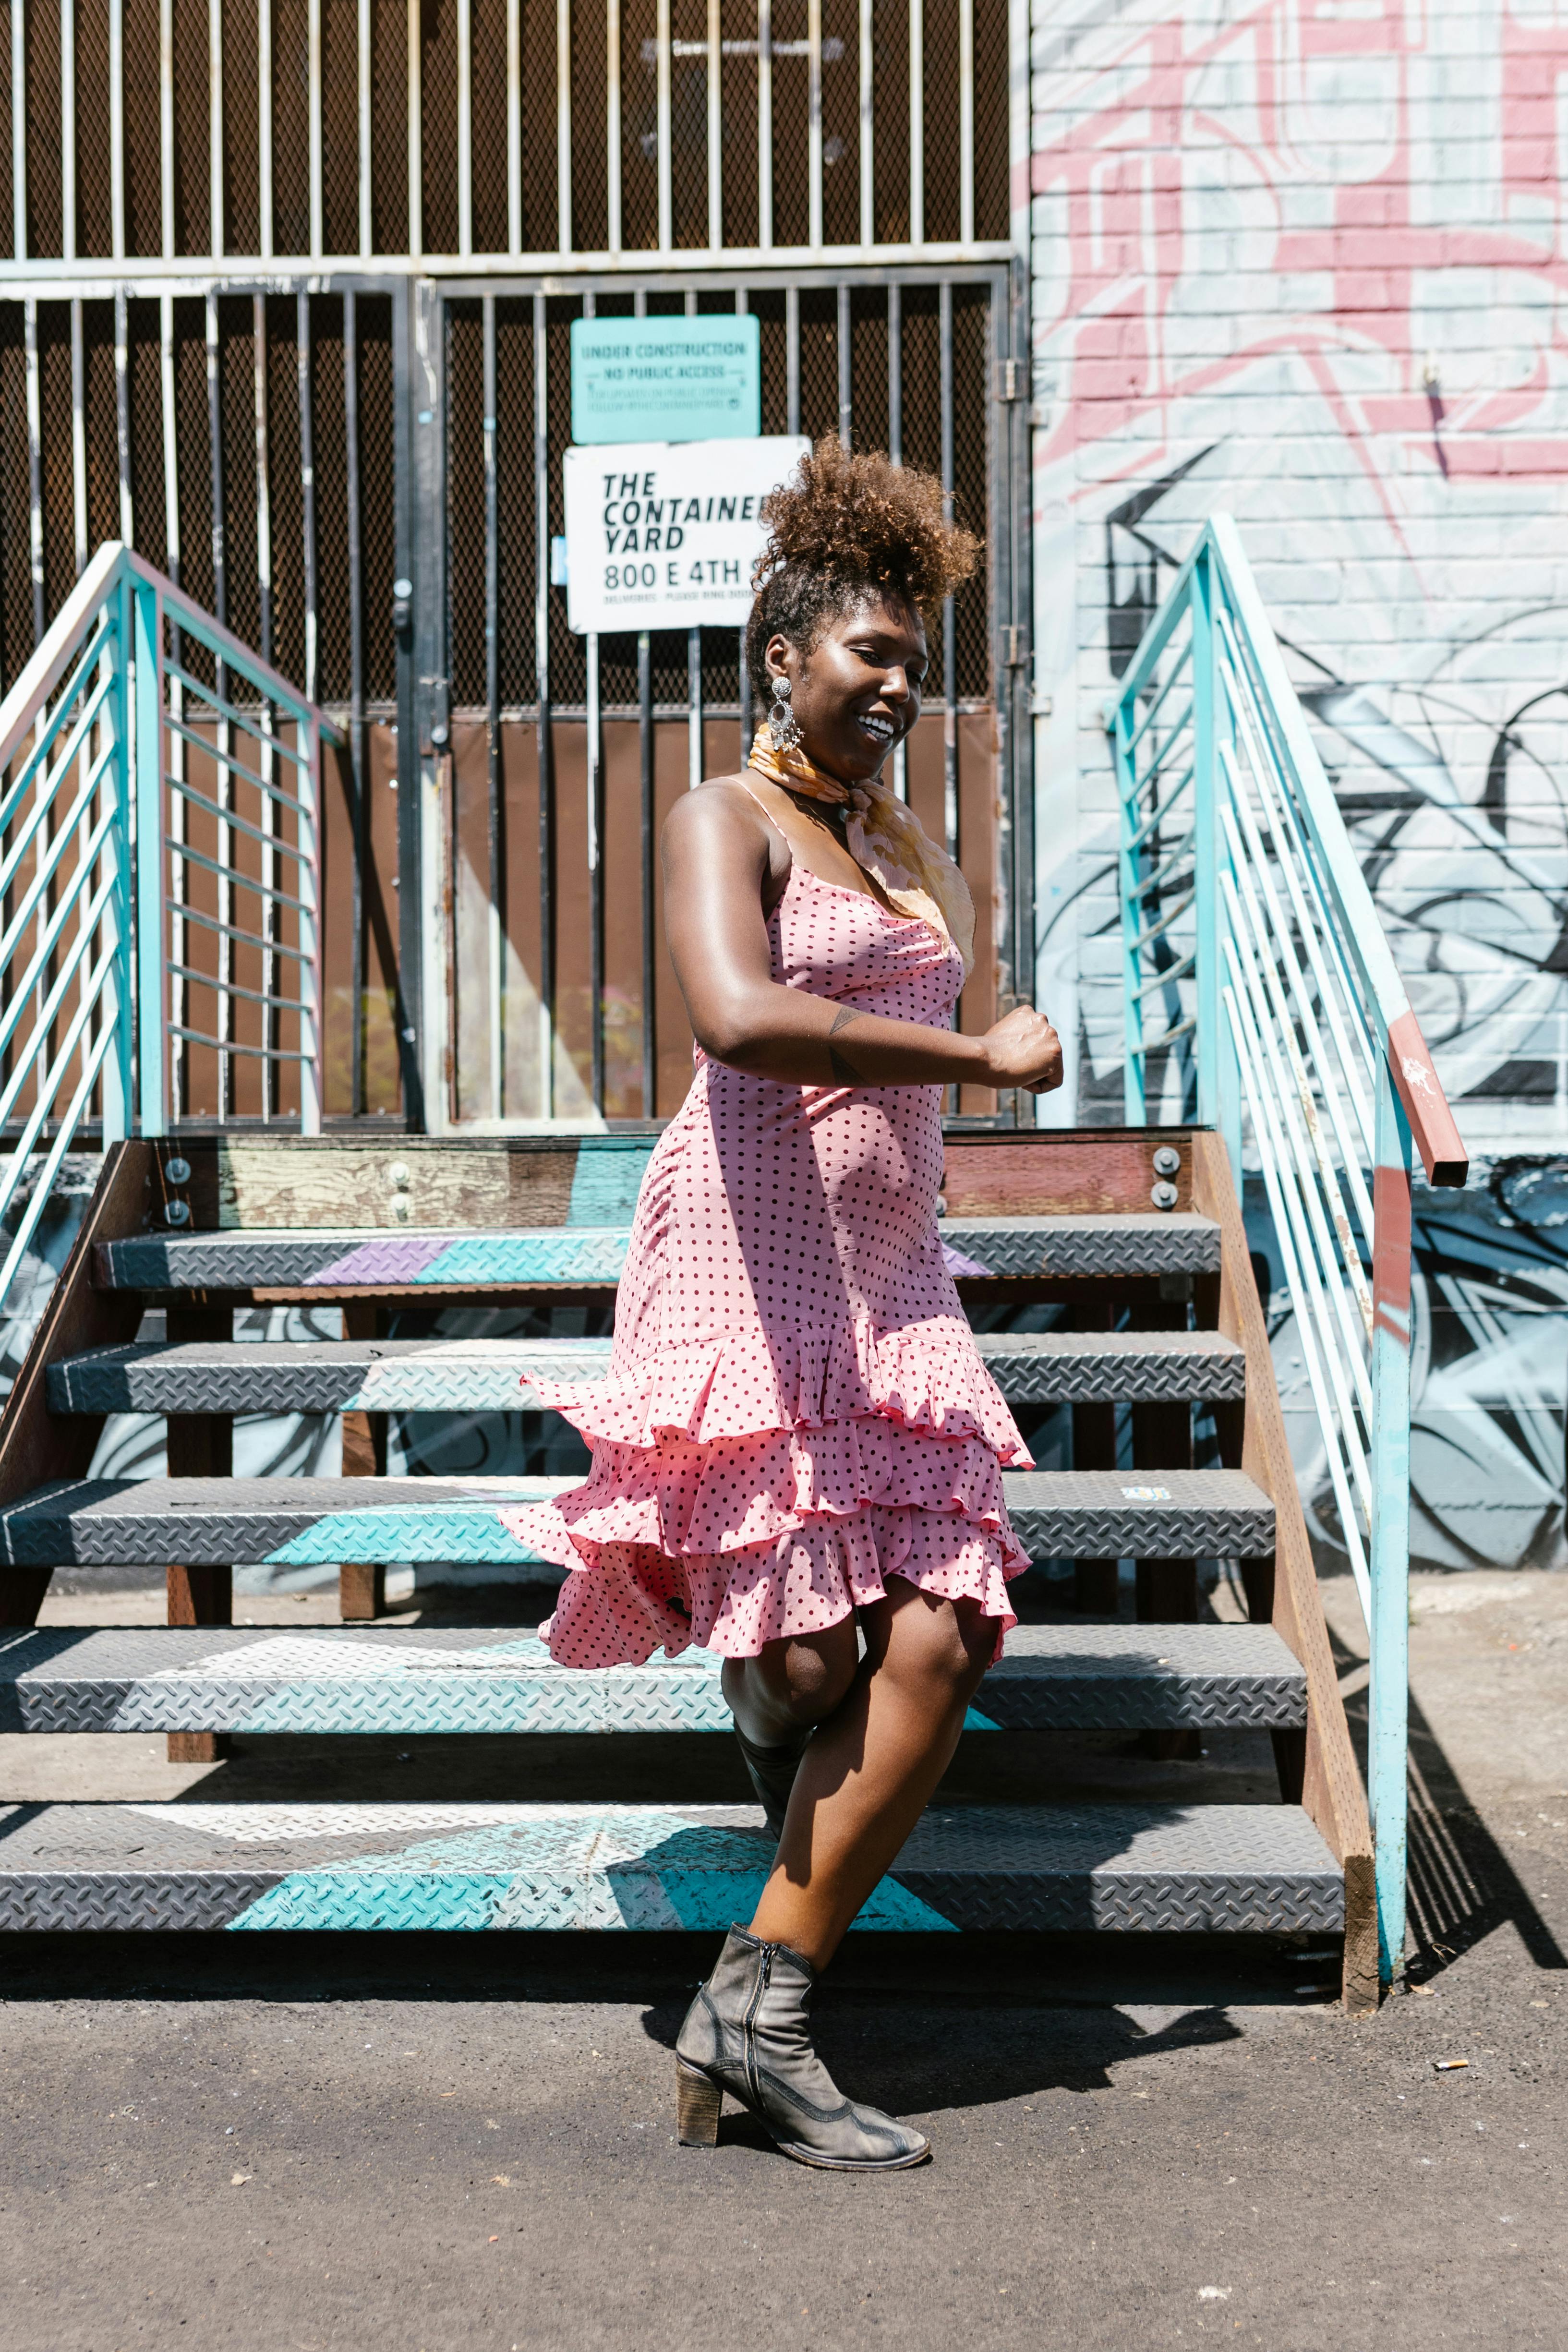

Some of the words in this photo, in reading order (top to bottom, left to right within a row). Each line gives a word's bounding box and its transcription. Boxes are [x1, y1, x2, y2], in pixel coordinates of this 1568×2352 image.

[581, 345, 632, 359] UNDER
[635, 342, 747, 358] CONSTRUCTION
[604, 368, 624, 380] NO
[627, 366, 673, 380] PUBLIC
[677, 365, 725, 378] ACCESS
[603, 472, 656, 498] THE
[605, 527, 684, 554] YARD
[605, 563, 657, 590] 800
[668, 562, 680, 586] E
[689, 560, 740, 585] 4TH
